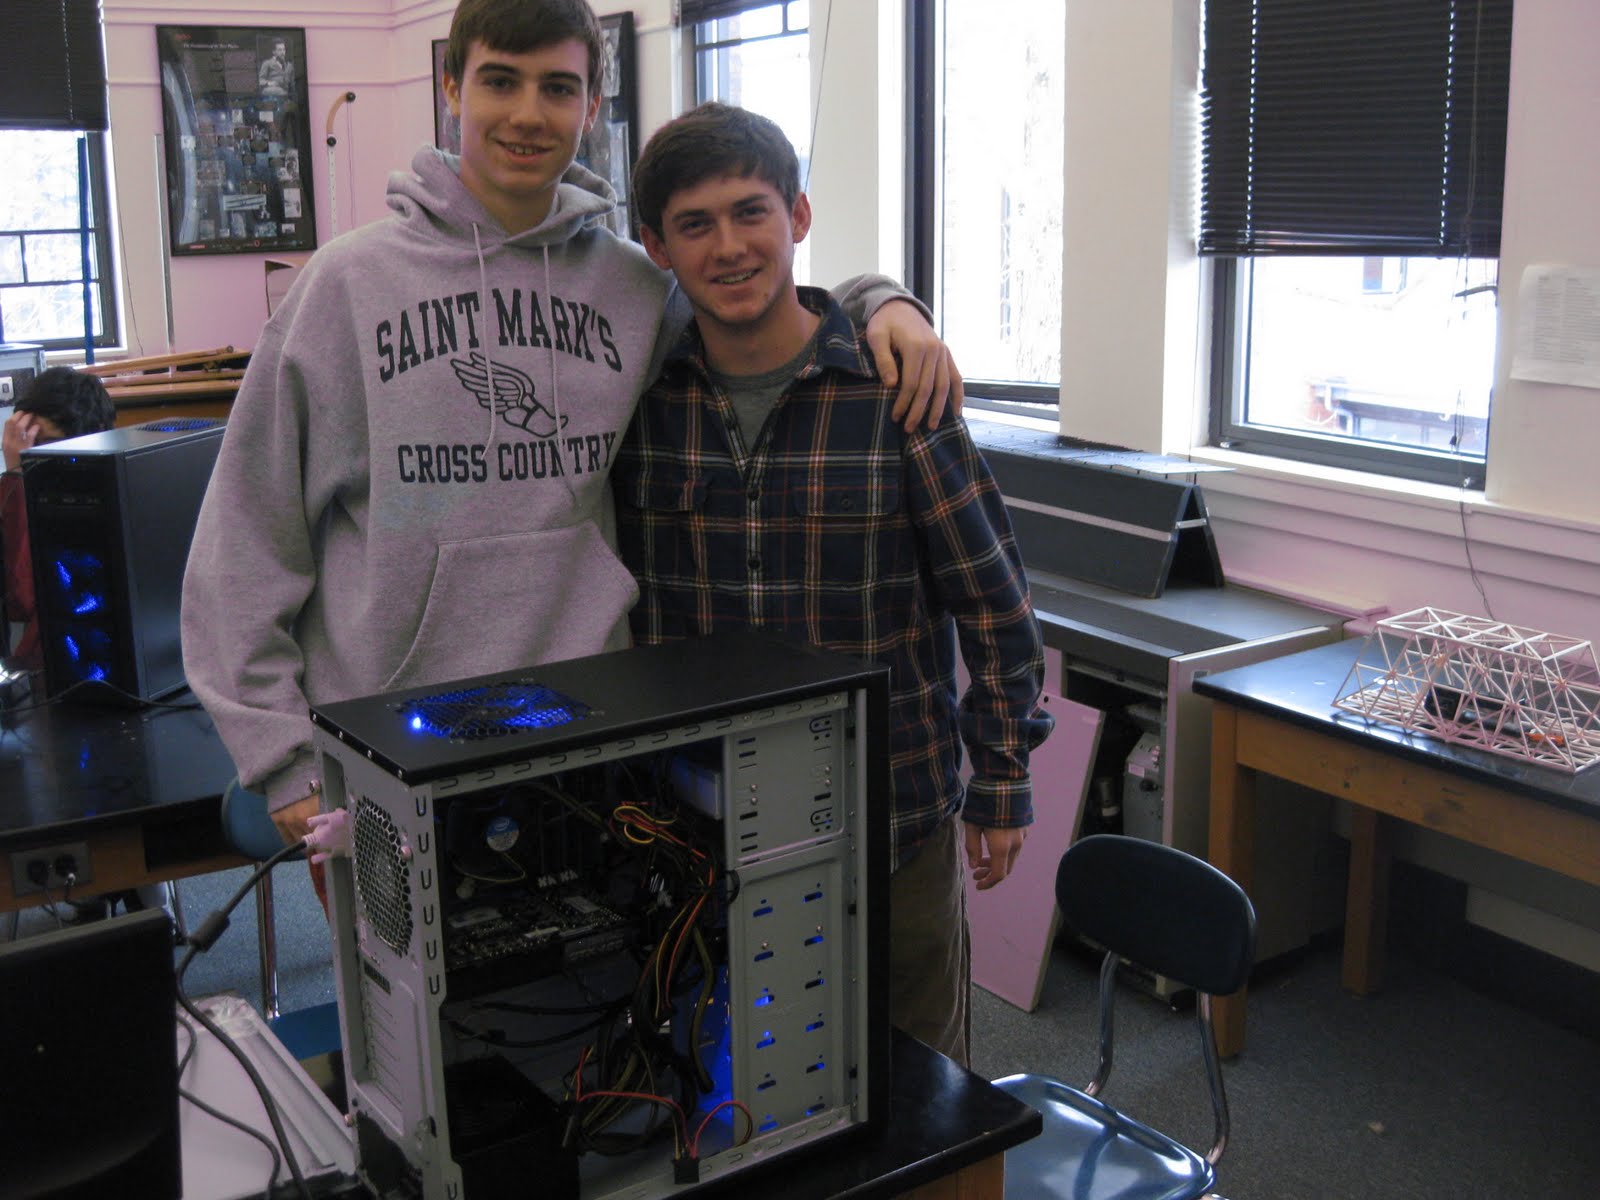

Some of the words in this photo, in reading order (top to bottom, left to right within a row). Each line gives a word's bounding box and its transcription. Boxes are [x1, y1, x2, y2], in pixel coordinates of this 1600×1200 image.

[376, 291, 480, 383] SAINT
[492, 288, 622, 373] MARK'S
[398, 444, 487, 483] CROSS
[497, 431, 616, 481] COUNTRY
